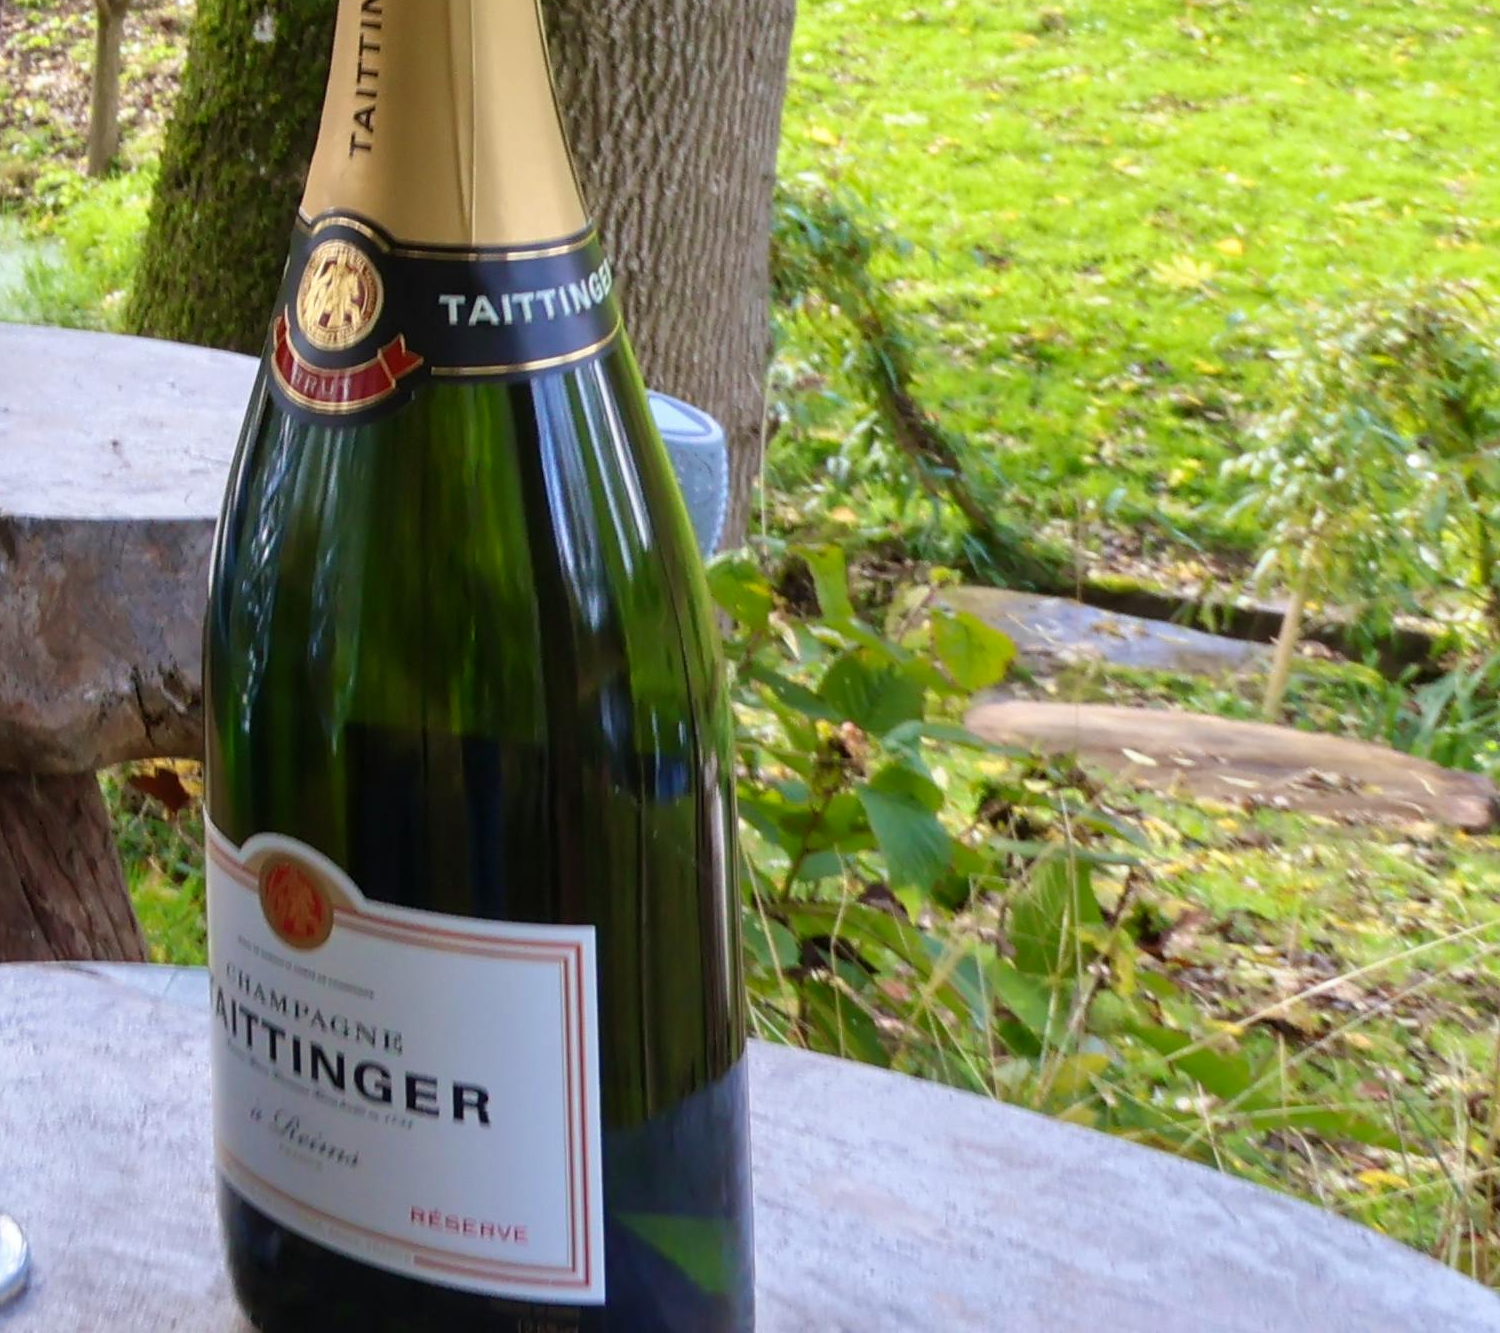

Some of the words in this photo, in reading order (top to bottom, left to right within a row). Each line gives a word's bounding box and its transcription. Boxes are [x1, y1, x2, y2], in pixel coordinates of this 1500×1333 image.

[438, 257, 613, 327] TAITTINGE
[290, 363, 353, 399] BRUT
[226, 962, 404, 1055] CHAMPAGNE
[409, 1204, 529, 1244] RÉSERVE
